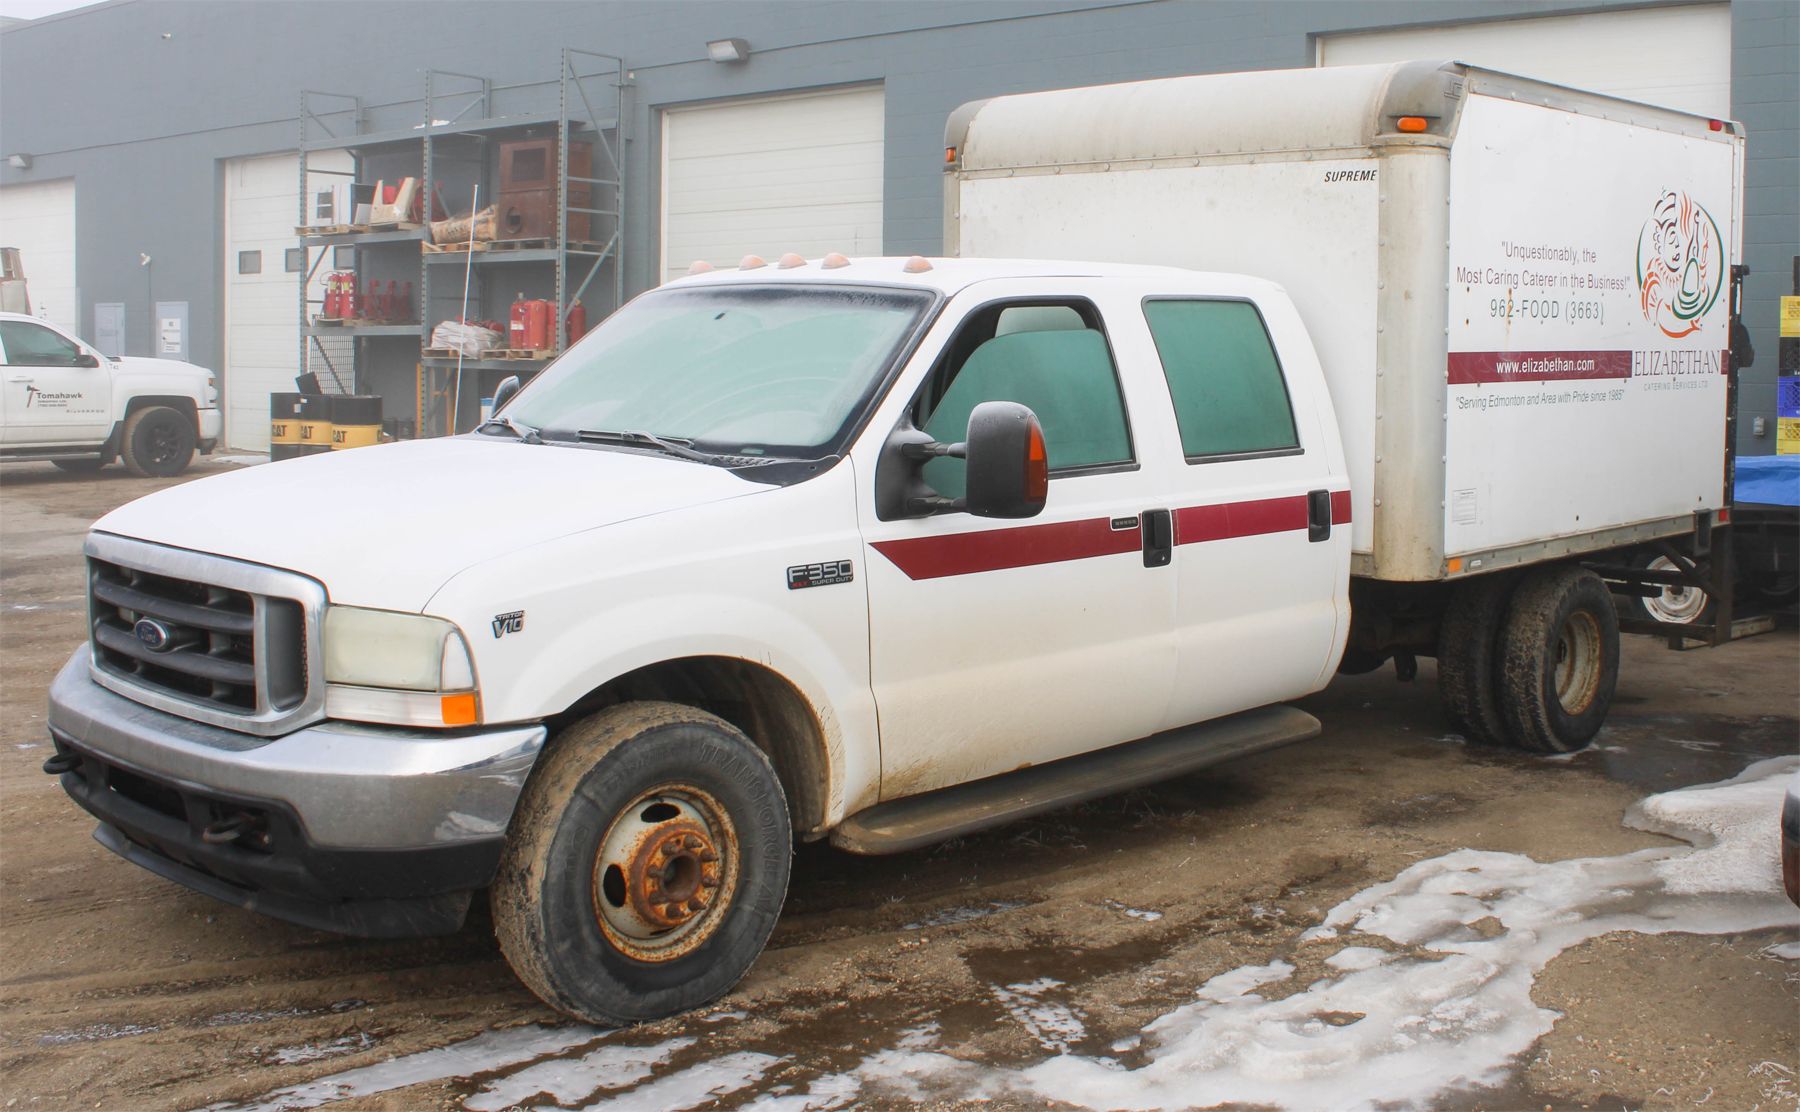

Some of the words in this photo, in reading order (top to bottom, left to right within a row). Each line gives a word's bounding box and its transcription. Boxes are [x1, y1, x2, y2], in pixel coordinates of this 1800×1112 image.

[1324, 169, 1377, 182] SUPREME
[1501, 241, 1579, 265] "Unquestionably,
[1582, 247, 1597, 263] the
[1456, 266, 1482, 284] Most
[1486, 268, 1519, 290] Caring
[1522, 270, 1557, 287] Caterer
[1560, 272, 1568, 288] in
[1570, 272, 1585, 289] the
[1587, 273, 1631, 290] Business!"
[1490, 298, 1560, 318] 962-FOOD
[1565, 301, 1604, 324] (3663)
[1496, 357, 1595, 374] www.elizabethan.com
[1634, 350, 1720, 376] ELIZABETHAN
[1456, 396, 1487, 411] "Serving
[1488, 394, 1526, 408] Edmonton
[1527, 392, 1540, 405] and
[1541, 391, 1557, 405] Area
[1572, 389, 1589, 403] Pride
[1590, 391, 1607, 402] since
[492, 618, 525, 639] V10
